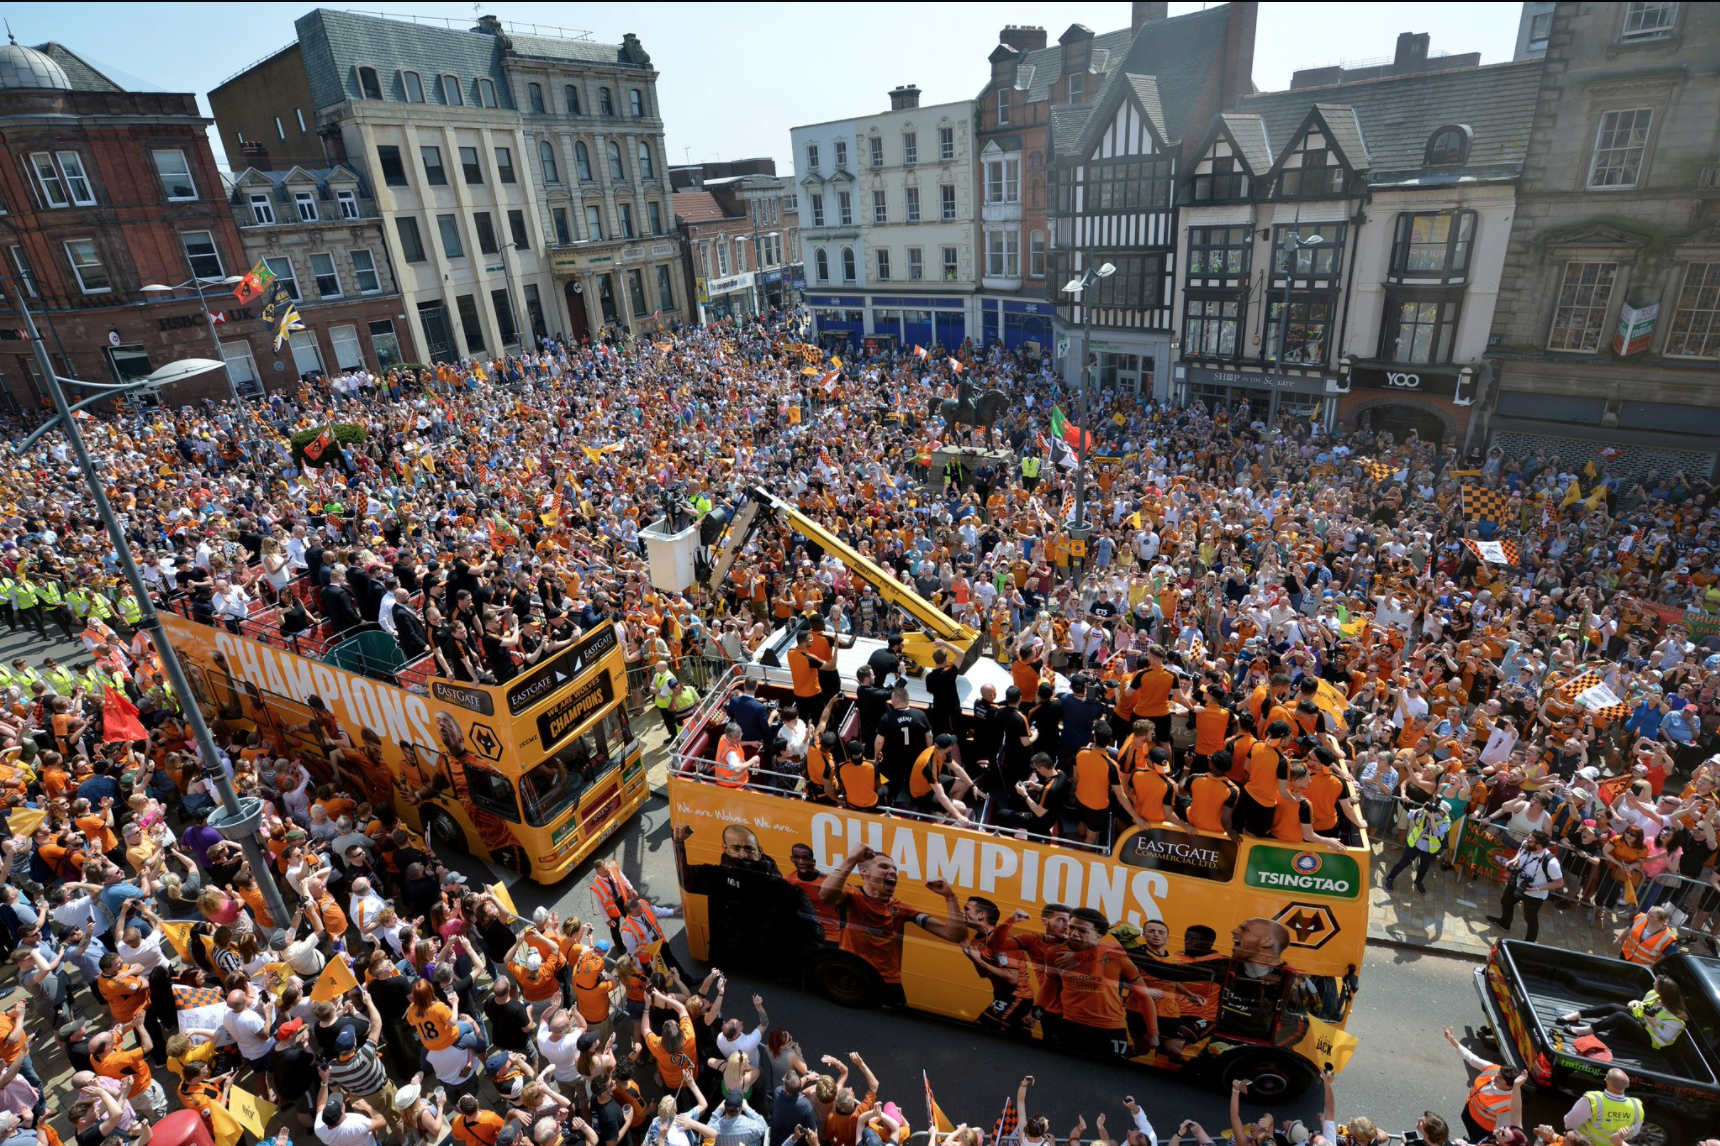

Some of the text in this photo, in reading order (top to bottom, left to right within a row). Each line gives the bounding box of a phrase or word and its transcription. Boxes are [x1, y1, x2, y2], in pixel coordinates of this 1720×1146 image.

[159, 307, 255, 331] HSBC UK
[1386, 372, 1420, 388] YOO
[215, 632, 439, 767] CHAMPIONS
[546, 675, 600, 717] WE ARE WOLVES
[549, 688, 604, 739] CHAMPIONS
[901, 726, 910, 745] 1
[677, 801, 692, 814] We
[754, 817, 771, 829] We
[1135, 848, 1217, 870] COMMERCIAL LTD.
[1137, 836, 1219, 863] EASTGATE
[811, 812, 1169, 929] CHAMPIONS
[1258, 870, 1349, 892] TSINGTAO
[418, 1020, 440, 1041] 18
[1111, 1039, 1128, 1055] 17
[1654, 1083, 1717, 1100] recruitment
[1607, 1111, 1631, 1119] CREW
